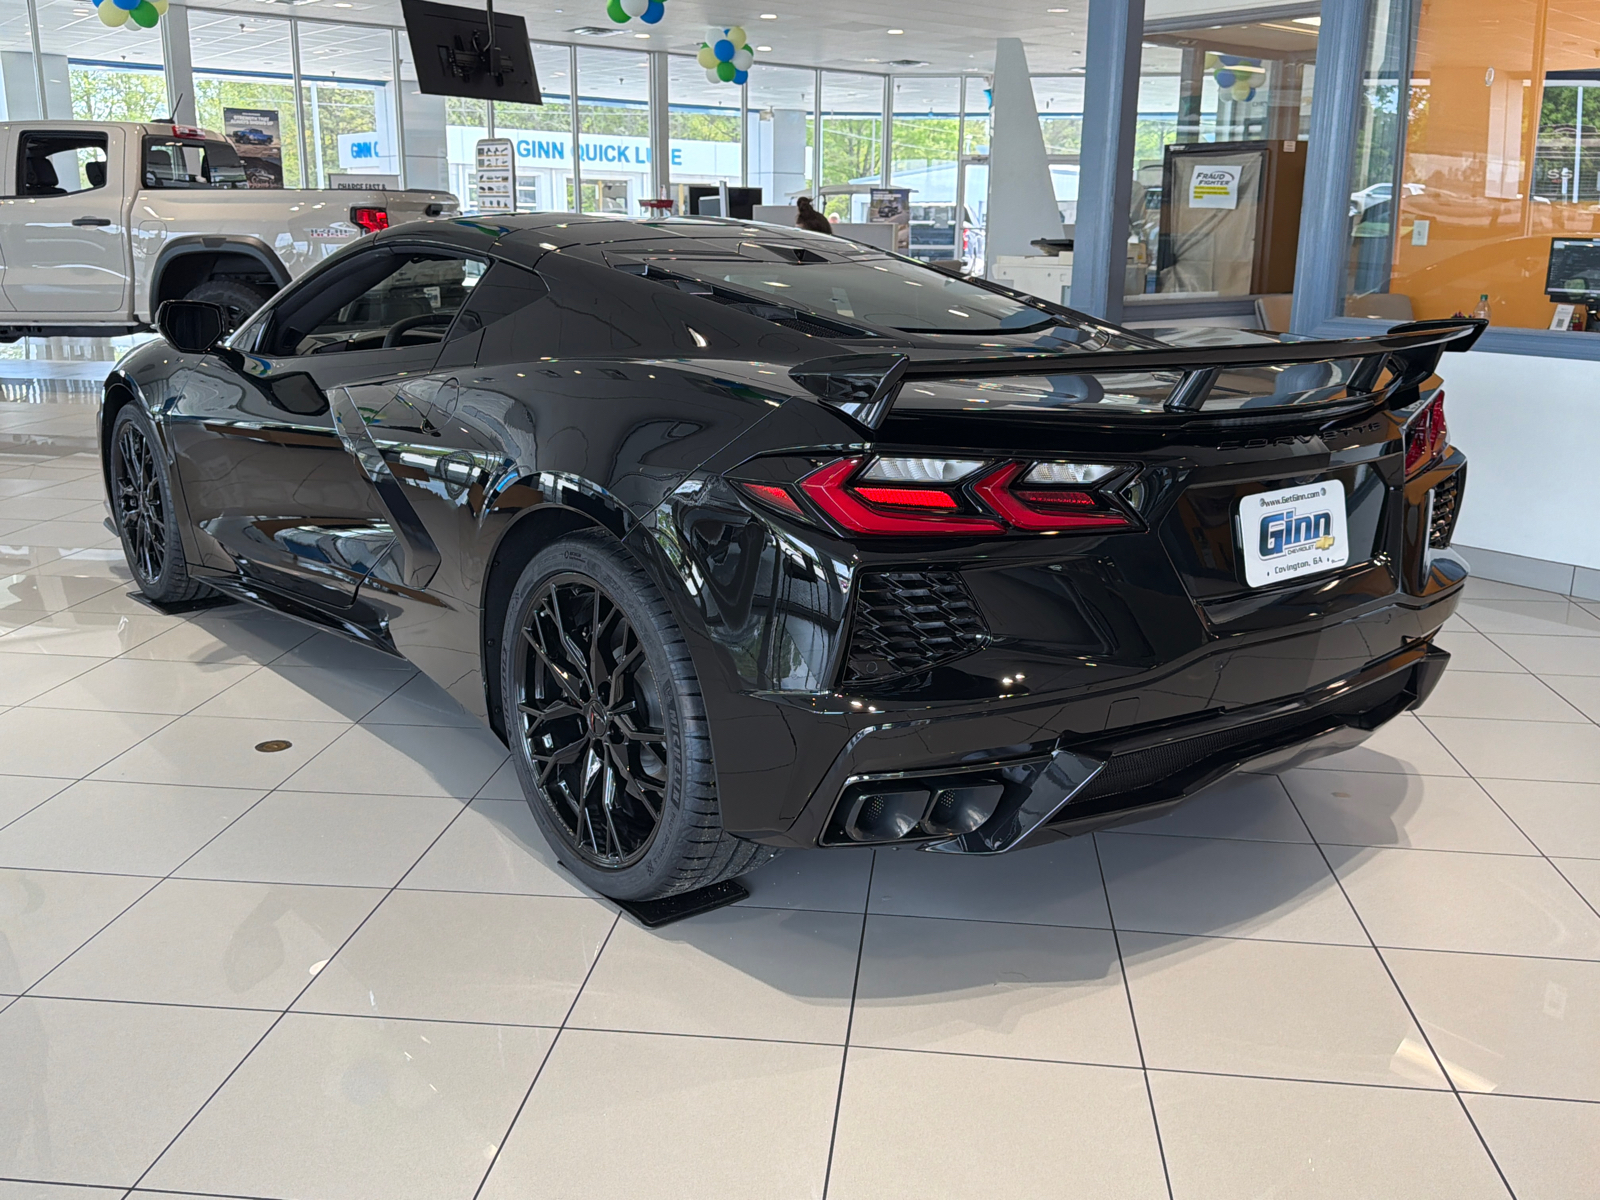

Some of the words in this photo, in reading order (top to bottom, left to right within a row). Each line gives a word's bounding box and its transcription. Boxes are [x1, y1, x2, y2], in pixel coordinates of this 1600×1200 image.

[516, 139, 565, 160] GINN
[570, 143, 631, 163] QUICK
[635, 146, 683, 166] LE
[1196, 172, 1226, 180] FRAUD
[1216, 422, 1381, 450] CORVETTE
[1264, 490, 1320, 507] www.GetGinn.com
[1258, 508, 1333, 560] Ginn
[1287, 544, 1314, 555] CHEVROLET
[1274, 559, 1311, 575] Covington,
[1312, 556, 1323, 565] GA
[668, 709, 683, 805] MICHELIN
